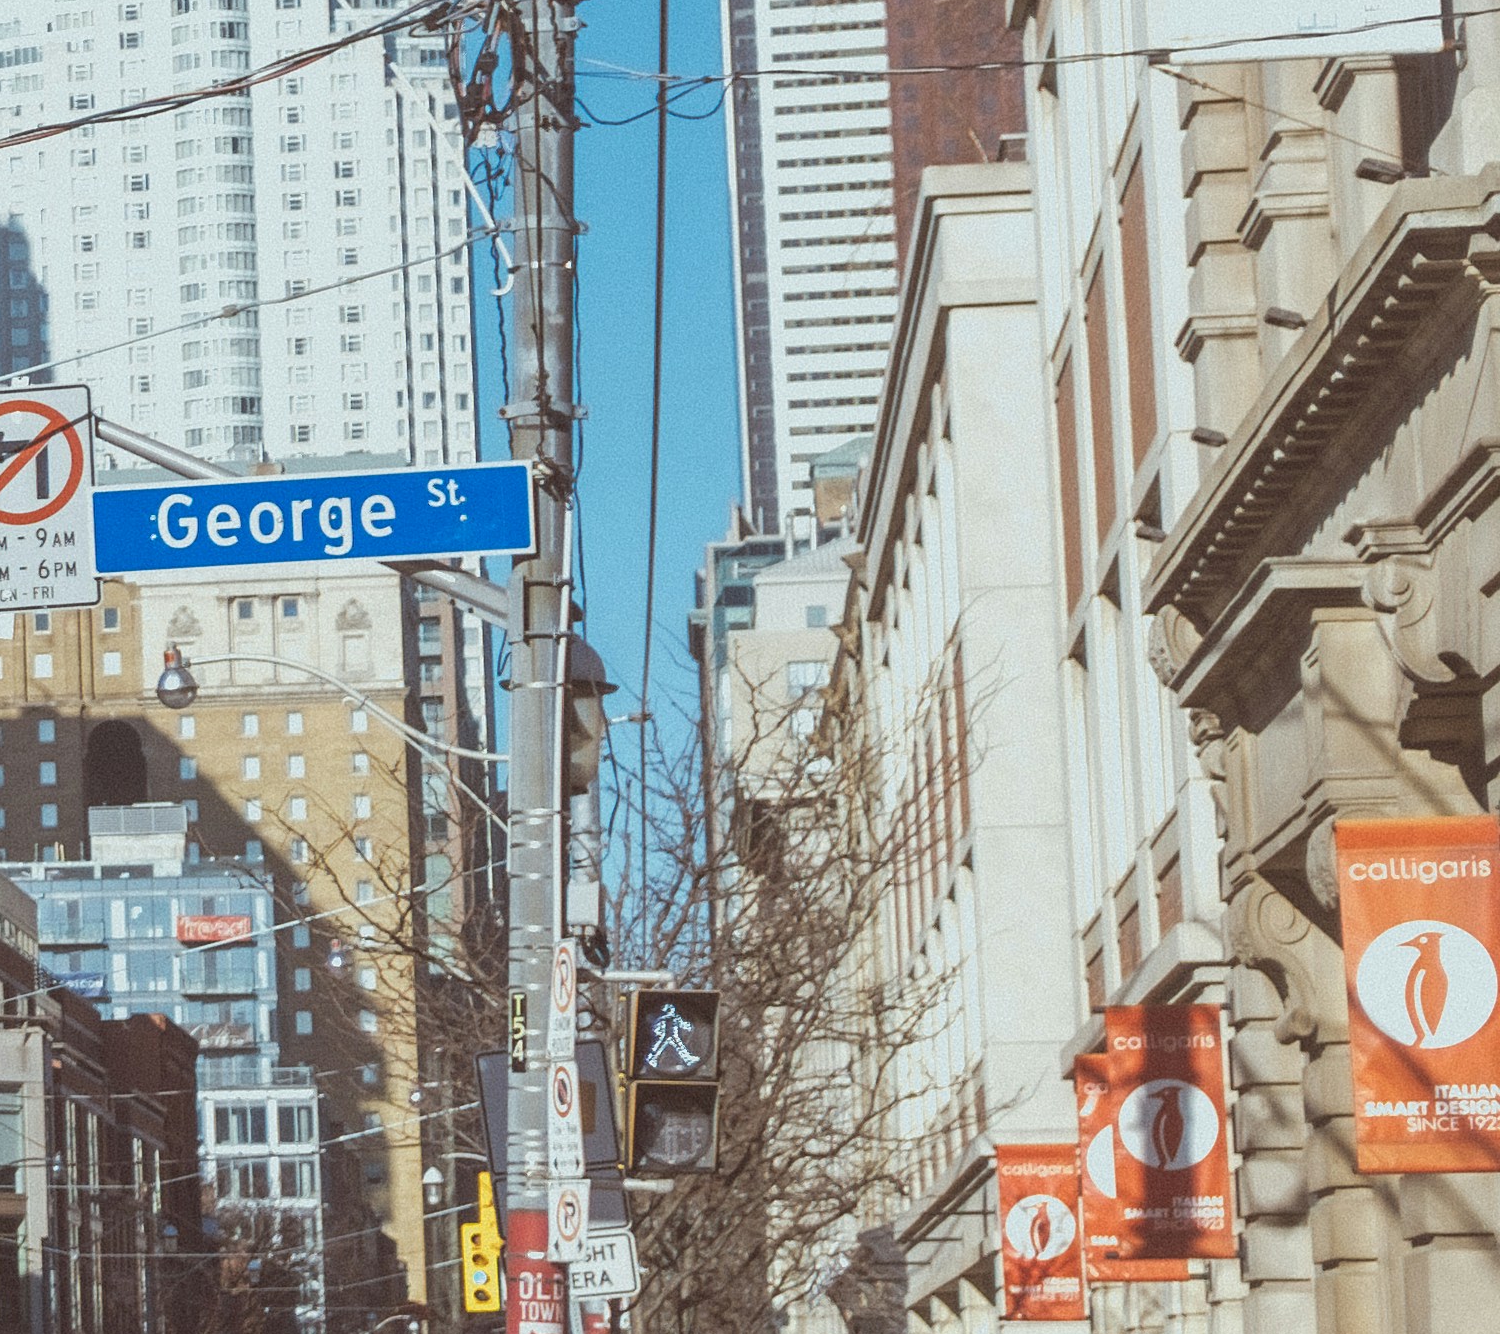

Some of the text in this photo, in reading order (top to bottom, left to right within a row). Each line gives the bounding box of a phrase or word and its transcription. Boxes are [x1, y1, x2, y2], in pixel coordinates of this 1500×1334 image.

[156, 492, 397, 556] George
[1348, 855, 1492, 885] calligaris
[512, 994, 525, 1062] T54
[1112, 1033, 1216, 1054] calligaris
[1434, 1083, 1500, 1100] ITALIAN
[1364, 1100, 1430, 1117] SMART
[1406, 1116, 1460, 1133] SINCE
[519, 1271, 564, 1300] OLD
